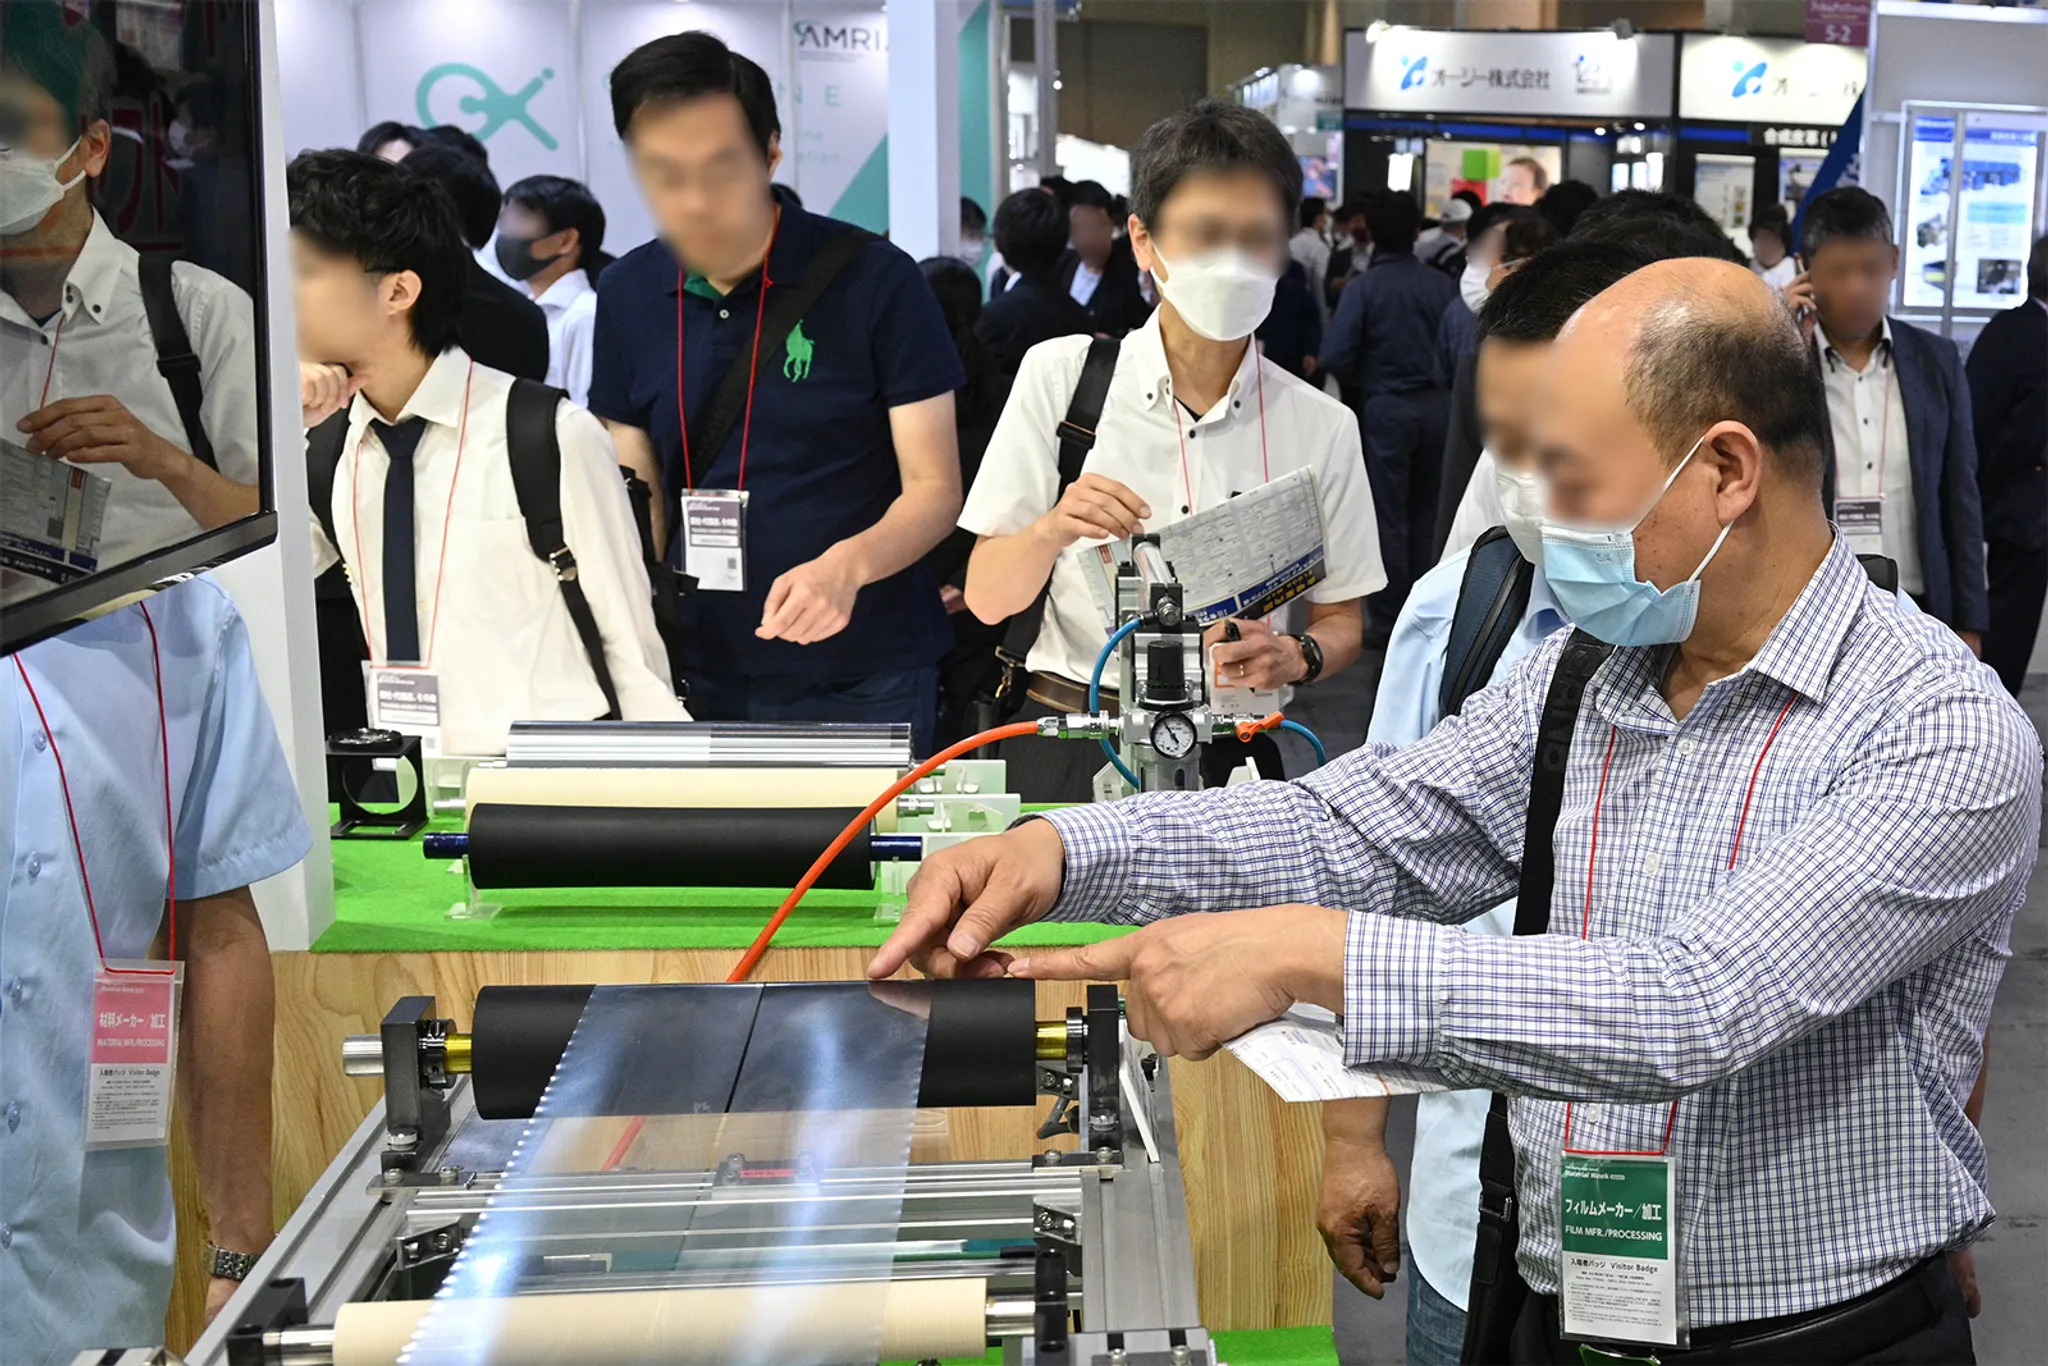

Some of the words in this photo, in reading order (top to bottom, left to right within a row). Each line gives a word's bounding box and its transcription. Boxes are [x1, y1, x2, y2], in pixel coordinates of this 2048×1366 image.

[798, 25, 889, 52] AMRI
[1431, 68, 1551, 90] オージー株式会社
[99, 1012, 166, 1029] 材料メーカー/加工
[1565, 1199, 1662, 1220] フィルムメーカー/加工
[1565, 1225, 1583, 1236] FILM
[1584, 1226, 1663, 1241] MFR./PROCESSING
[1610, 1262, 1634, 1271] Visitor
[1636, 1264, 1659, 1275] Badge
